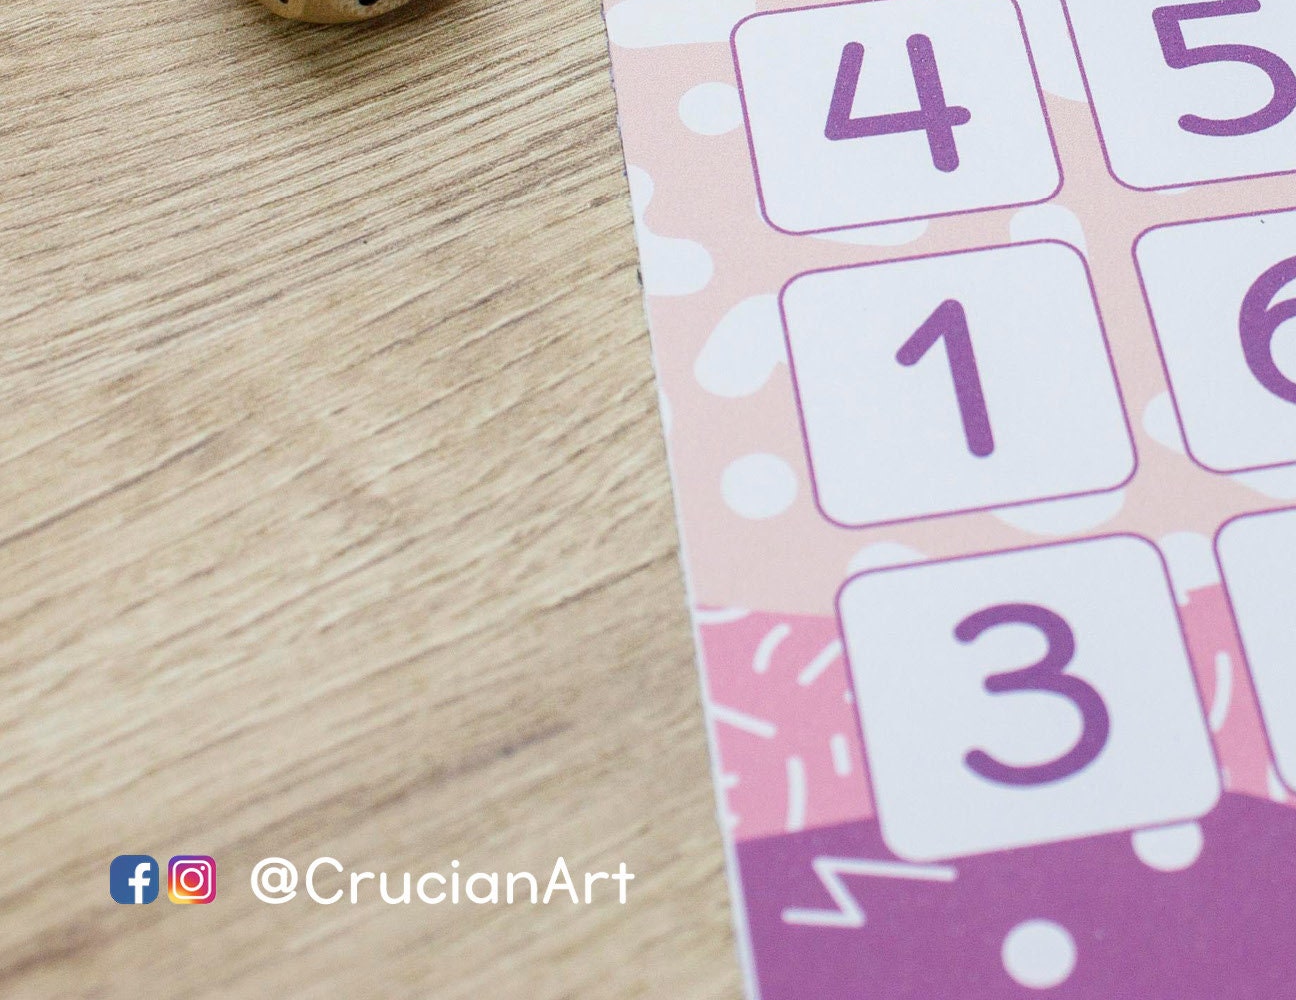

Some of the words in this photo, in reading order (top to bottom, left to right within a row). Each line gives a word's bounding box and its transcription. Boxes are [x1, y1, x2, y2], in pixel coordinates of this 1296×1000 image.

[824, 34, 971, 173] 4
[895, 300, 995, 458] 1
[954, 604, 1110, 787] 3
